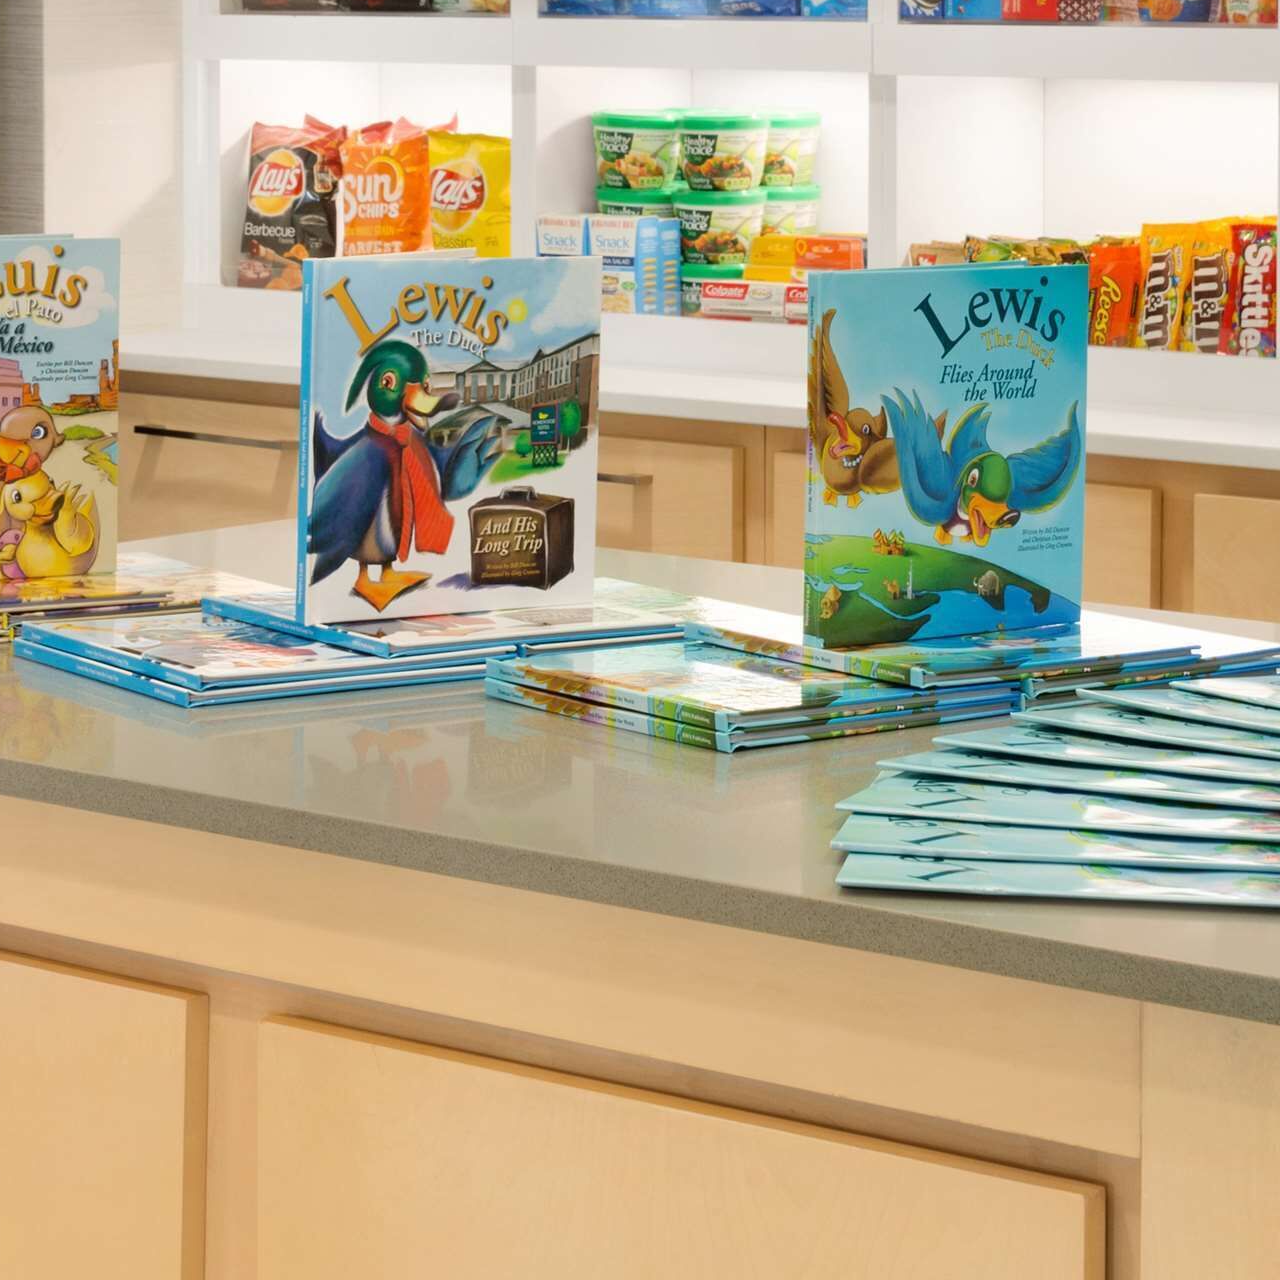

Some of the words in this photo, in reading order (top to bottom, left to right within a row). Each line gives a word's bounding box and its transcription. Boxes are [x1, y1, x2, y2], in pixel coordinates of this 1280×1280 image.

[358, 202, 400, 219] CHIPS
[244, 223, 297, 239] Barbecue
[704, 284, 745, 297] Colgate
[6, 300, 20, 319] el
[25, 297, 64, 324] Pato
[322, 275, 511, 357] Lewis
[913, 276, 1066, 360] Lewis
[1094, 276, 1122, 346] Reese
[14, 322, 25, 336] a
[410, 326, 443, 348] The
[447, 333, 488, 359] Duck
[980, 327, 1014, 352] The
[1016, 328, 1057, 369] Duck
[940, 363, 973, 385] Flies
[977, 359, 1035, 382] Around
[963, 382, 988, 402] the
[993, 379, 1036, 400] World
[480, 517, 513, 536] And
[513, 516, 538, 533] His
[473, 537, 511, 557] Long
[513, 534, 543, 554] Trip
